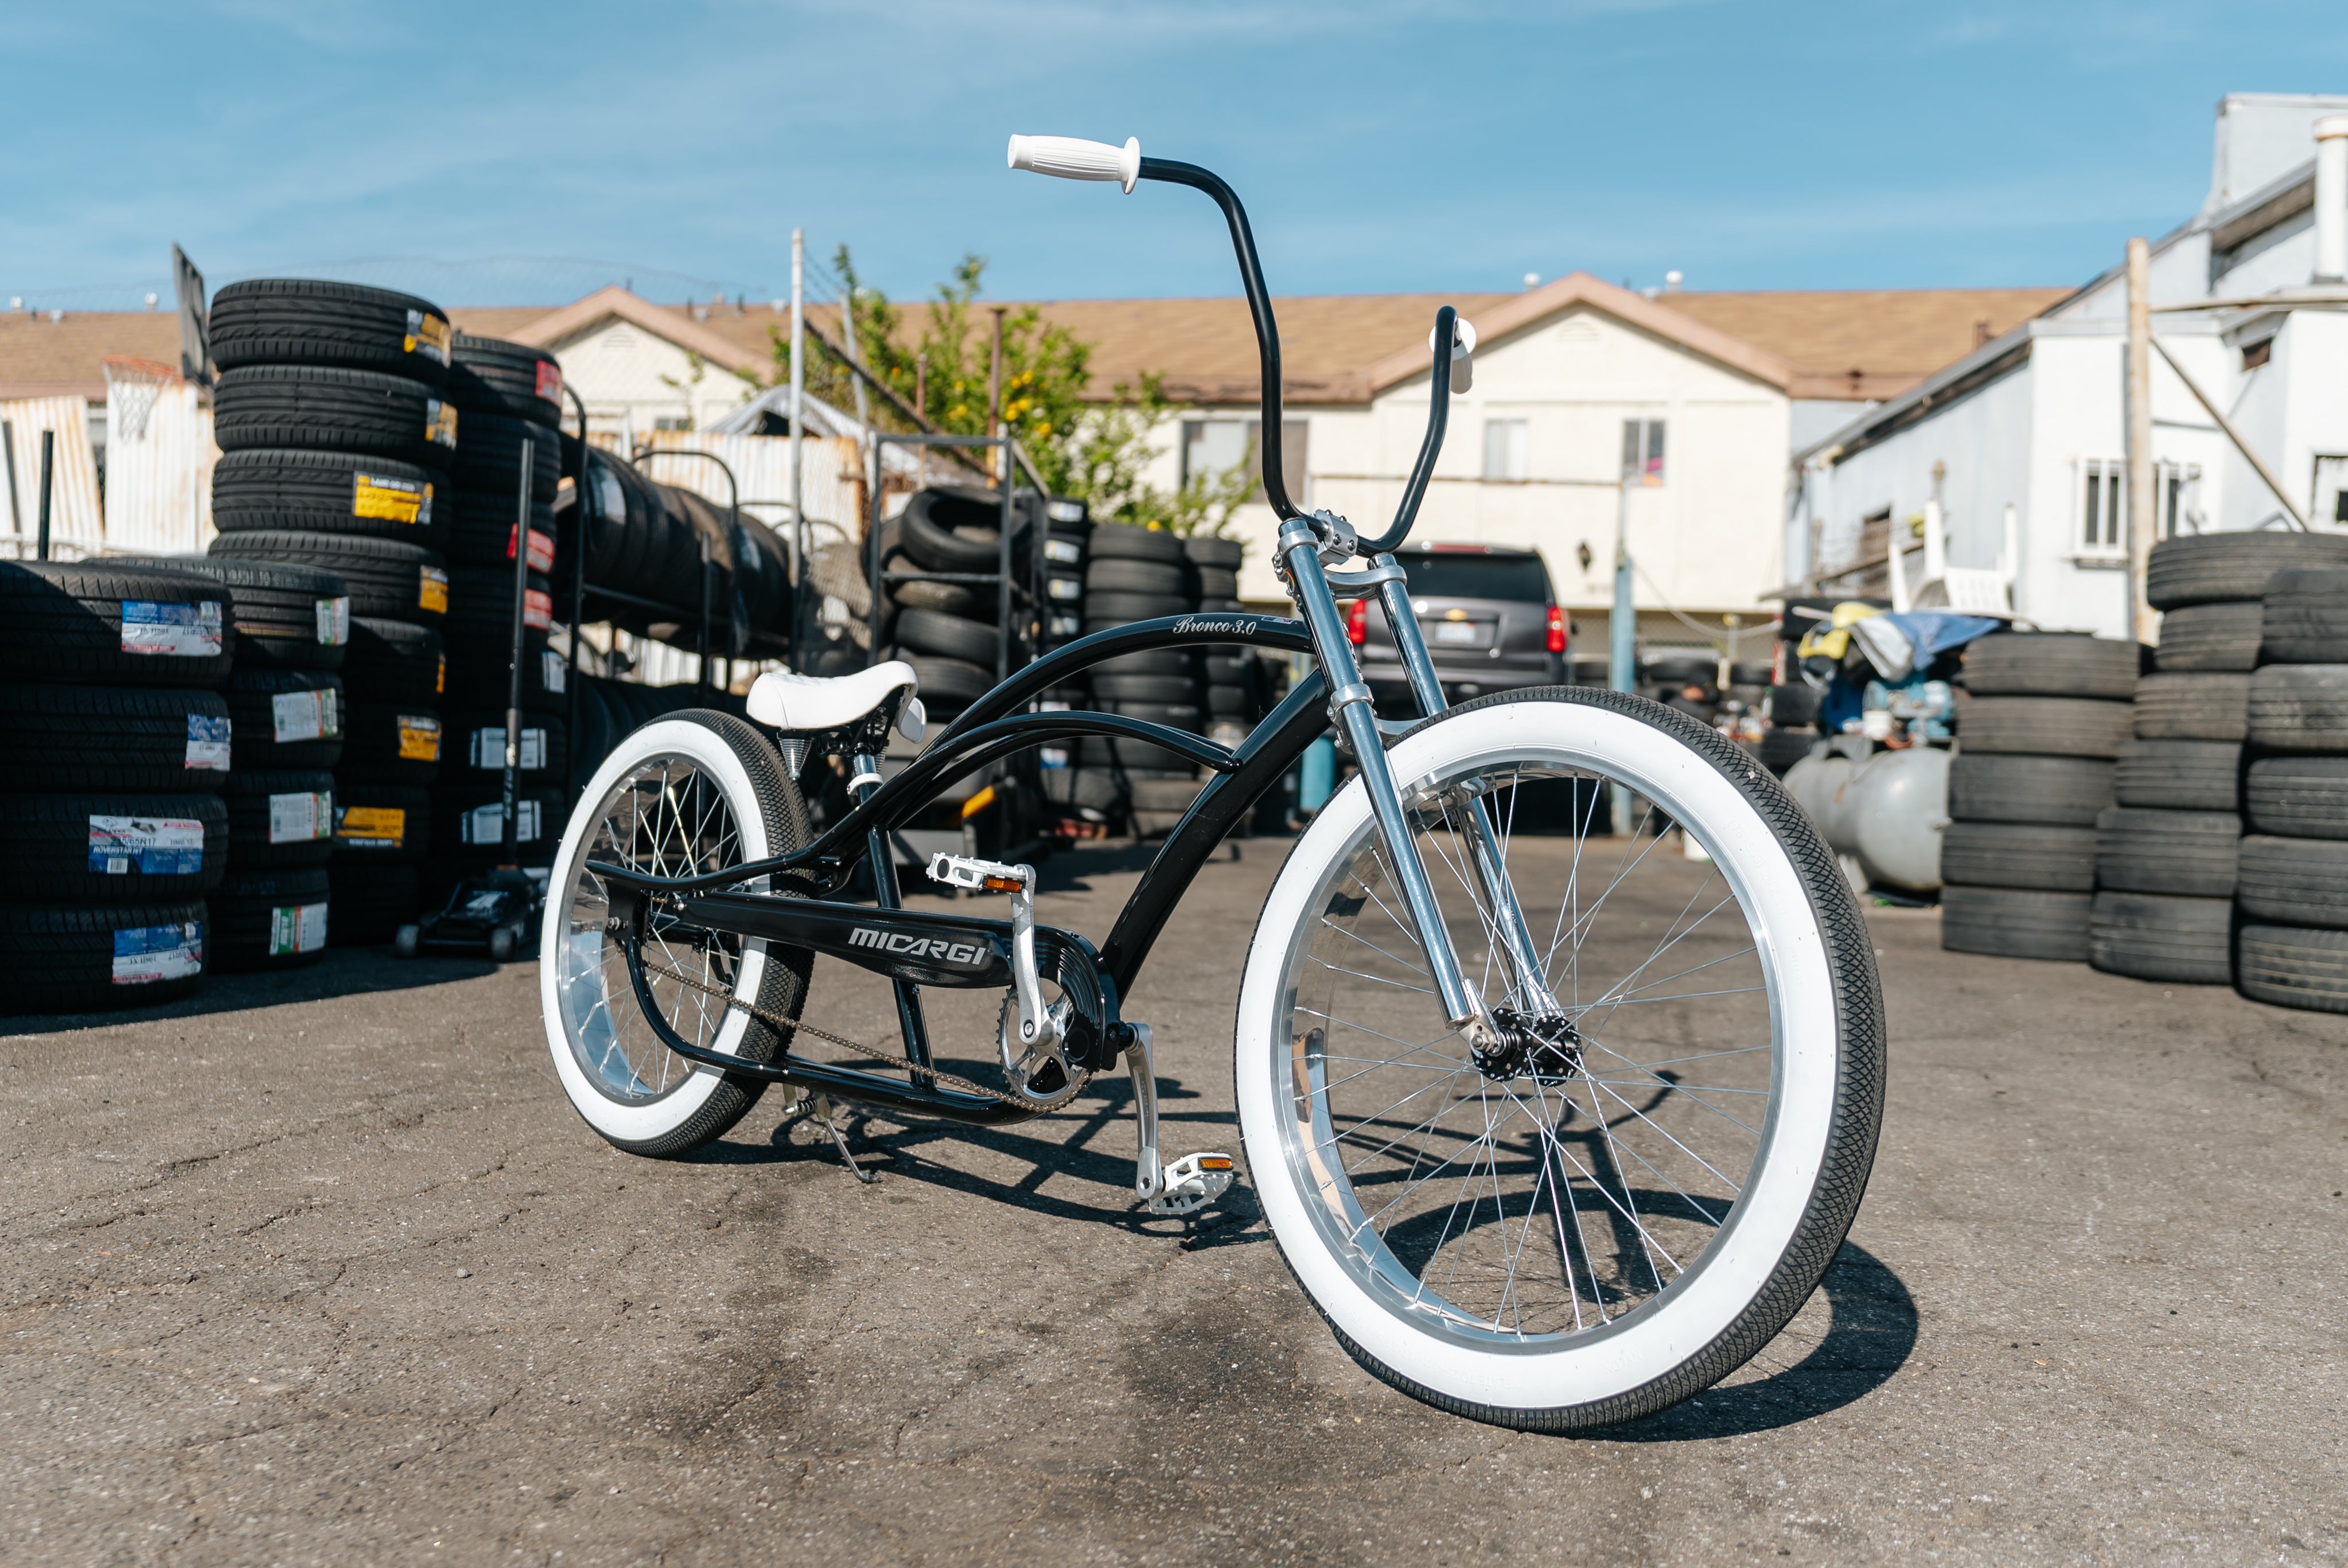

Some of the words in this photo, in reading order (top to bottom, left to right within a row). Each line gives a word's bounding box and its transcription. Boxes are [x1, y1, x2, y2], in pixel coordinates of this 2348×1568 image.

[1173, 617, 1232, 634] Bronco
[1232, 620, 1256, 635] 3.0
[848, 928, 986, 965] MICARGI
